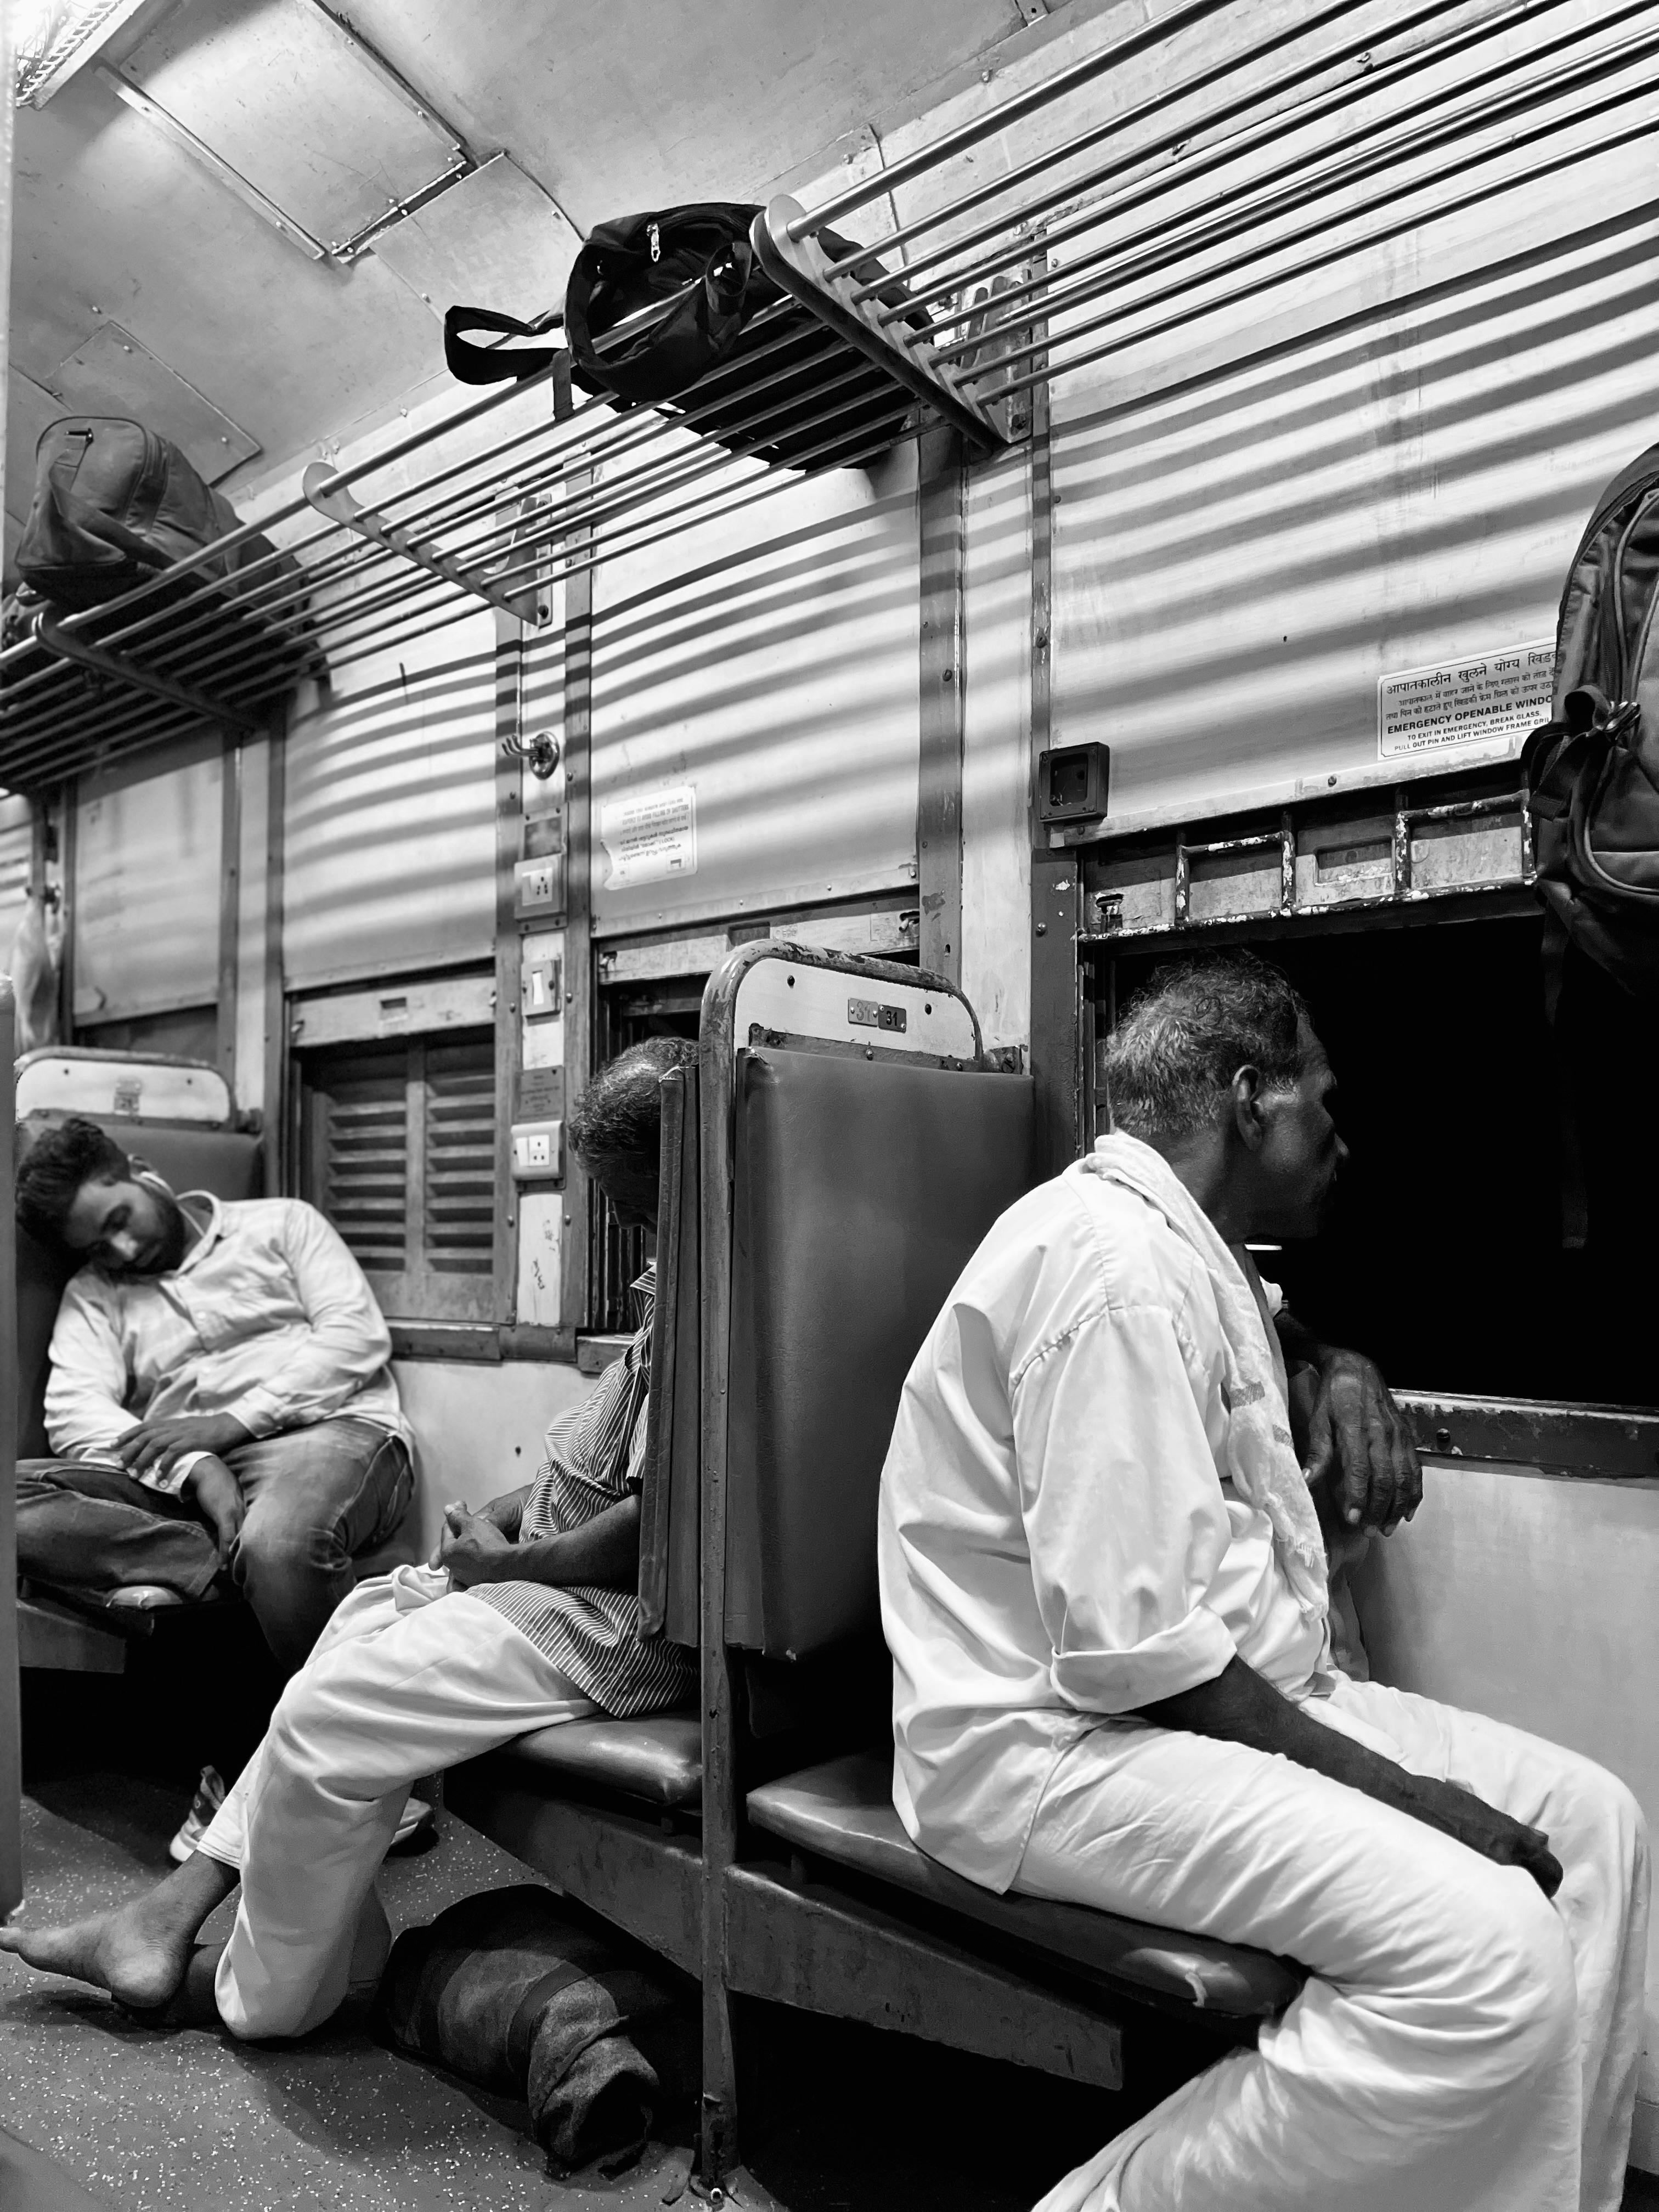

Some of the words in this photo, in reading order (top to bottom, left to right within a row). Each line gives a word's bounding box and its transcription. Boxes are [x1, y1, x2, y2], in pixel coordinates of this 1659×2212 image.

[1386, 672, 1451, 694] आपातकालीन
[1458, 663, 1487, 682] खुलने
[1494, 659, 1520, 672] योग्य
[1460, 684, 1474, 693] जाने
[1387, 715, 1452, 734] EMERGENCY
[1455, 703, 1513, 721] OPENABLE
[1490, 715, 1514, 725] BREAK
[1473, 726, 1504, 737] WINDOW
[1506, 720, 1532, 730] FRAME
[856, 1001, 871, 1022] 31
[886, 1011, 898, 1026] 31
